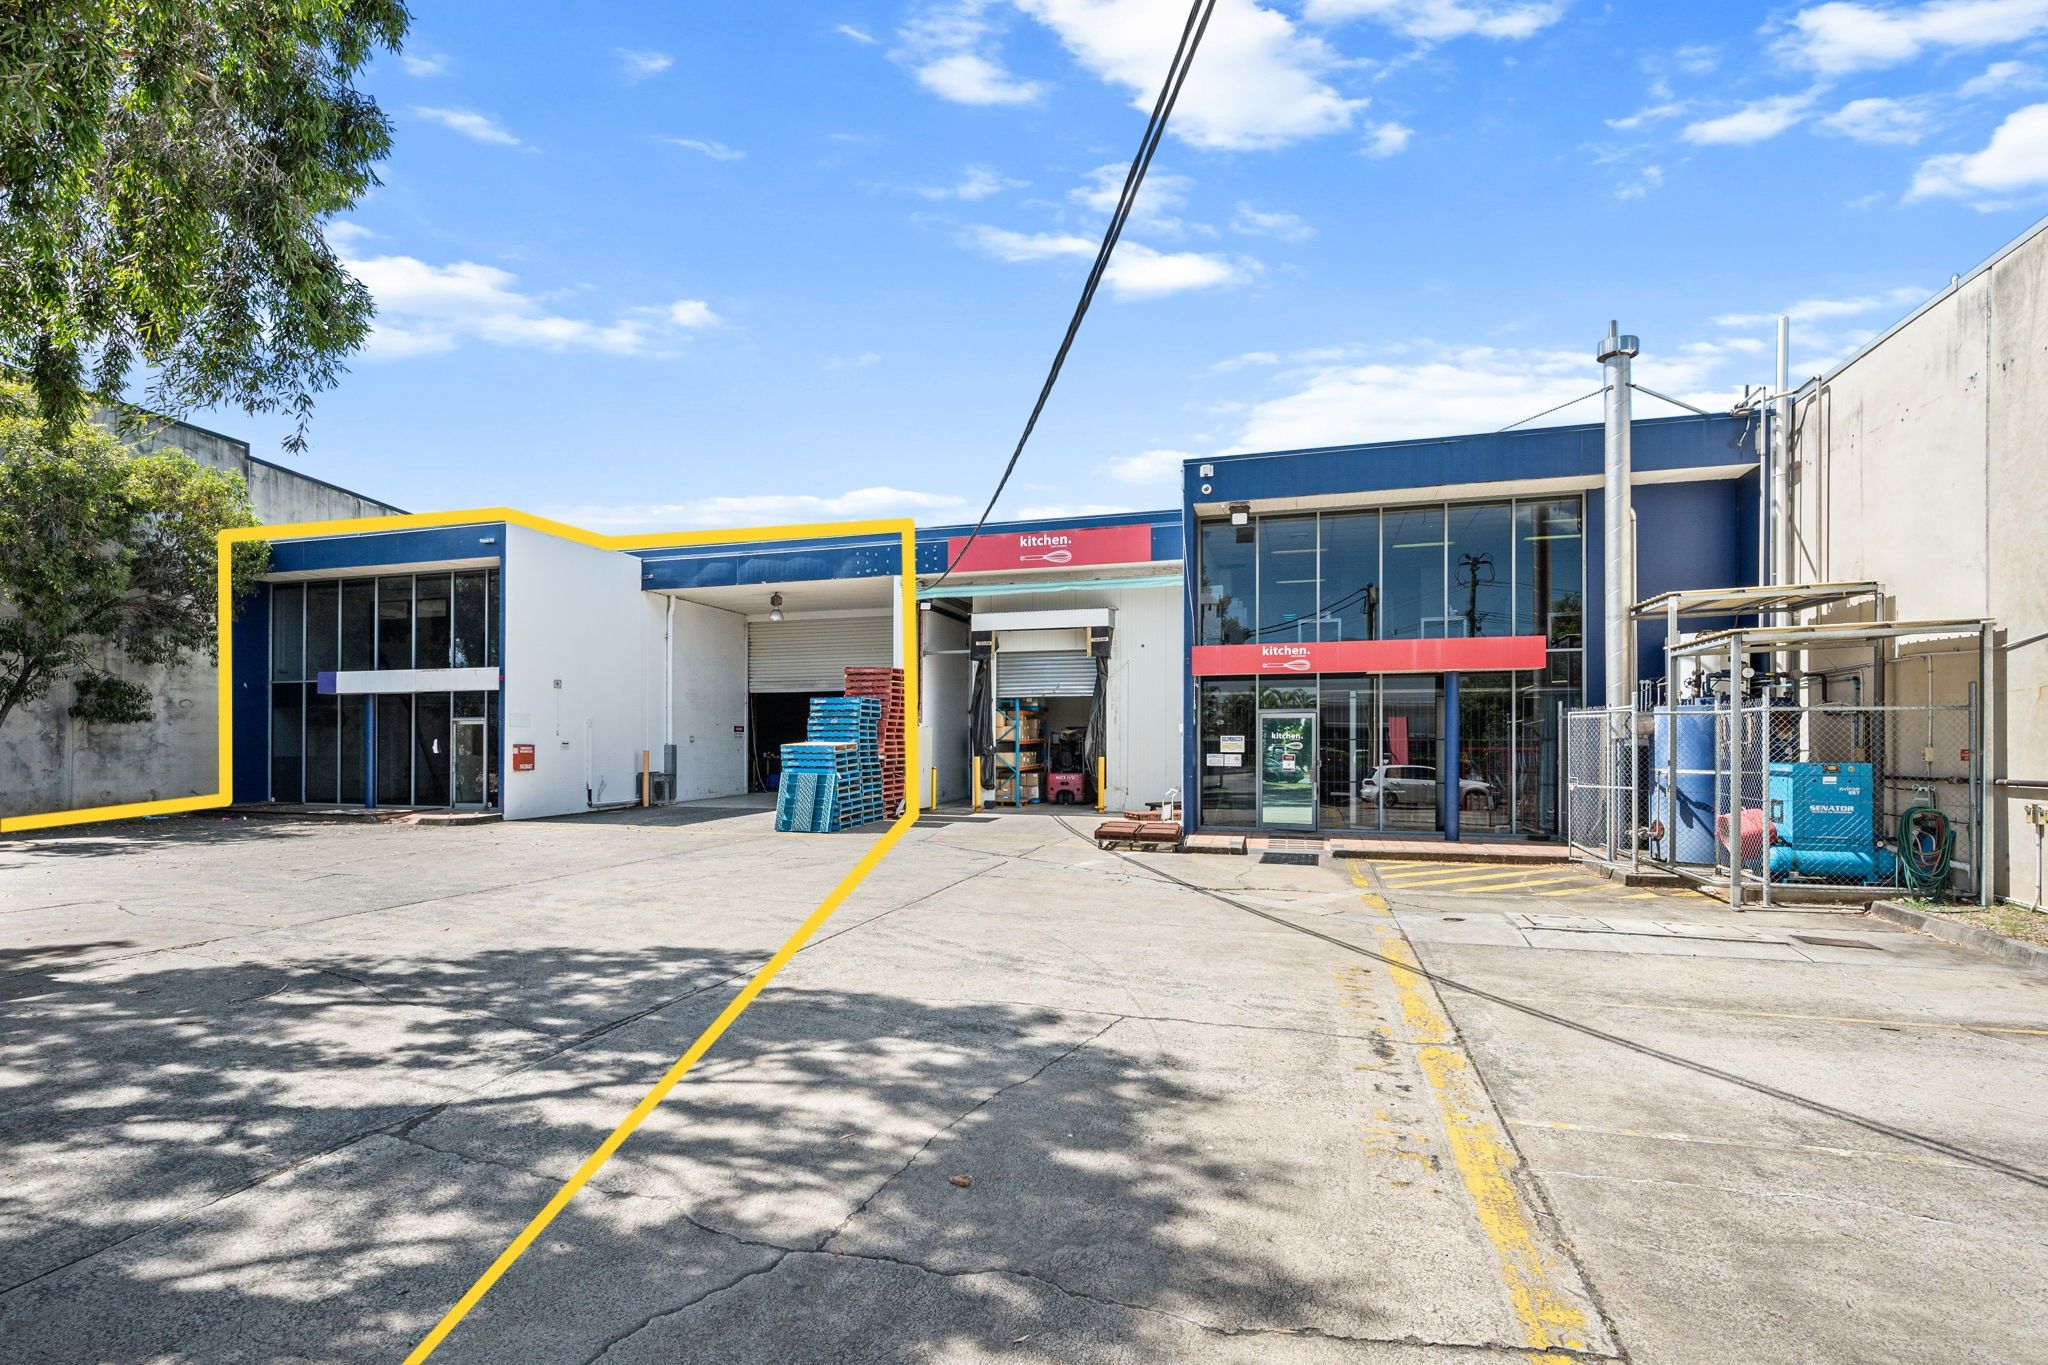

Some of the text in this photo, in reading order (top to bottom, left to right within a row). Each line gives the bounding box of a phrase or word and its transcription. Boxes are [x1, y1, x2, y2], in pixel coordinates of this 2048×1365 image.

[1020, 534, 1072, 547] kitchen.
[1262, 645, 1311, 656] kitchen.
[1271, 731, 1304, 740] kitchen.
[1809, 804, 1855, 812] SENATOR
